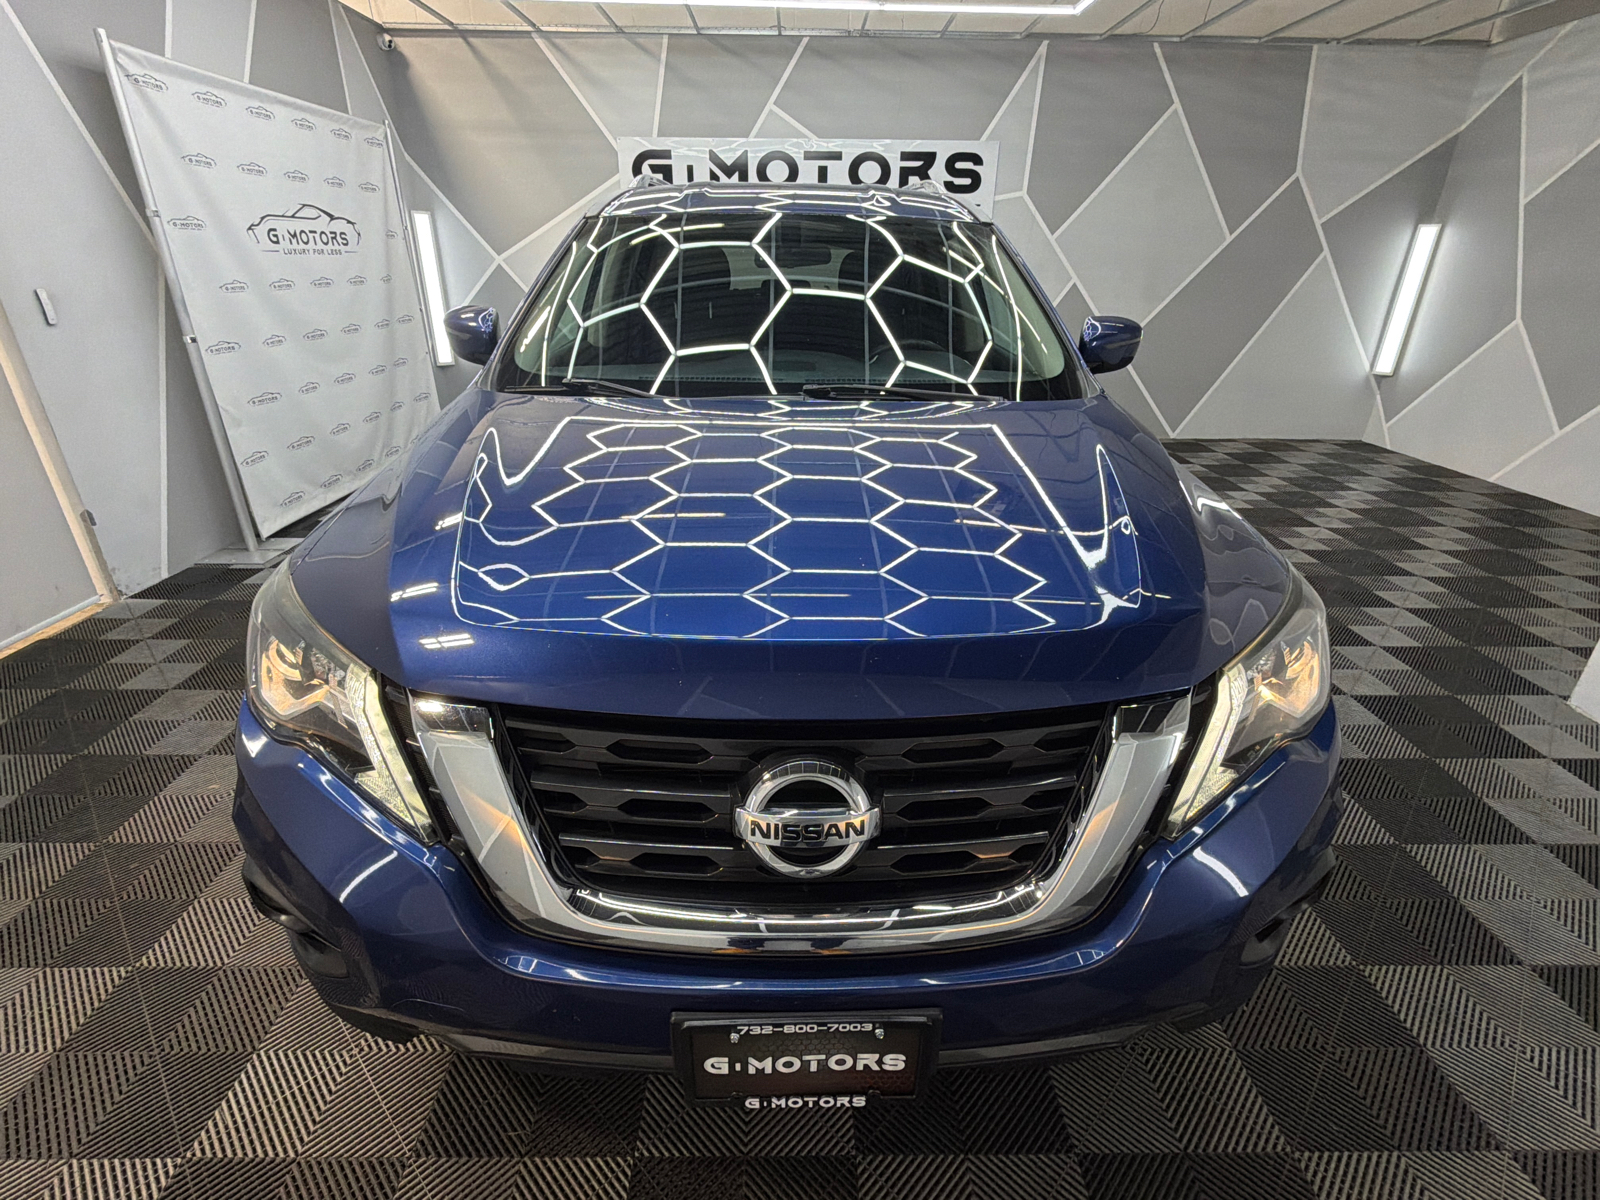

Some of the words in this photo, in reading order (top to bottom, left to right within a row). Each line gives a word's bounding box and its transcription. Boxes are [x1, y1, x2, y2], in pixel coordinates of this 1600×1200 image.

[283, 248, 310, 256] LUXURY
[313, 248, 325, 256] FOR
[327, 248, 342, 256] LESS
[750, 819, 865, 842] NISSAN
[737, 1023, 873, 1036] 732-800-7003
